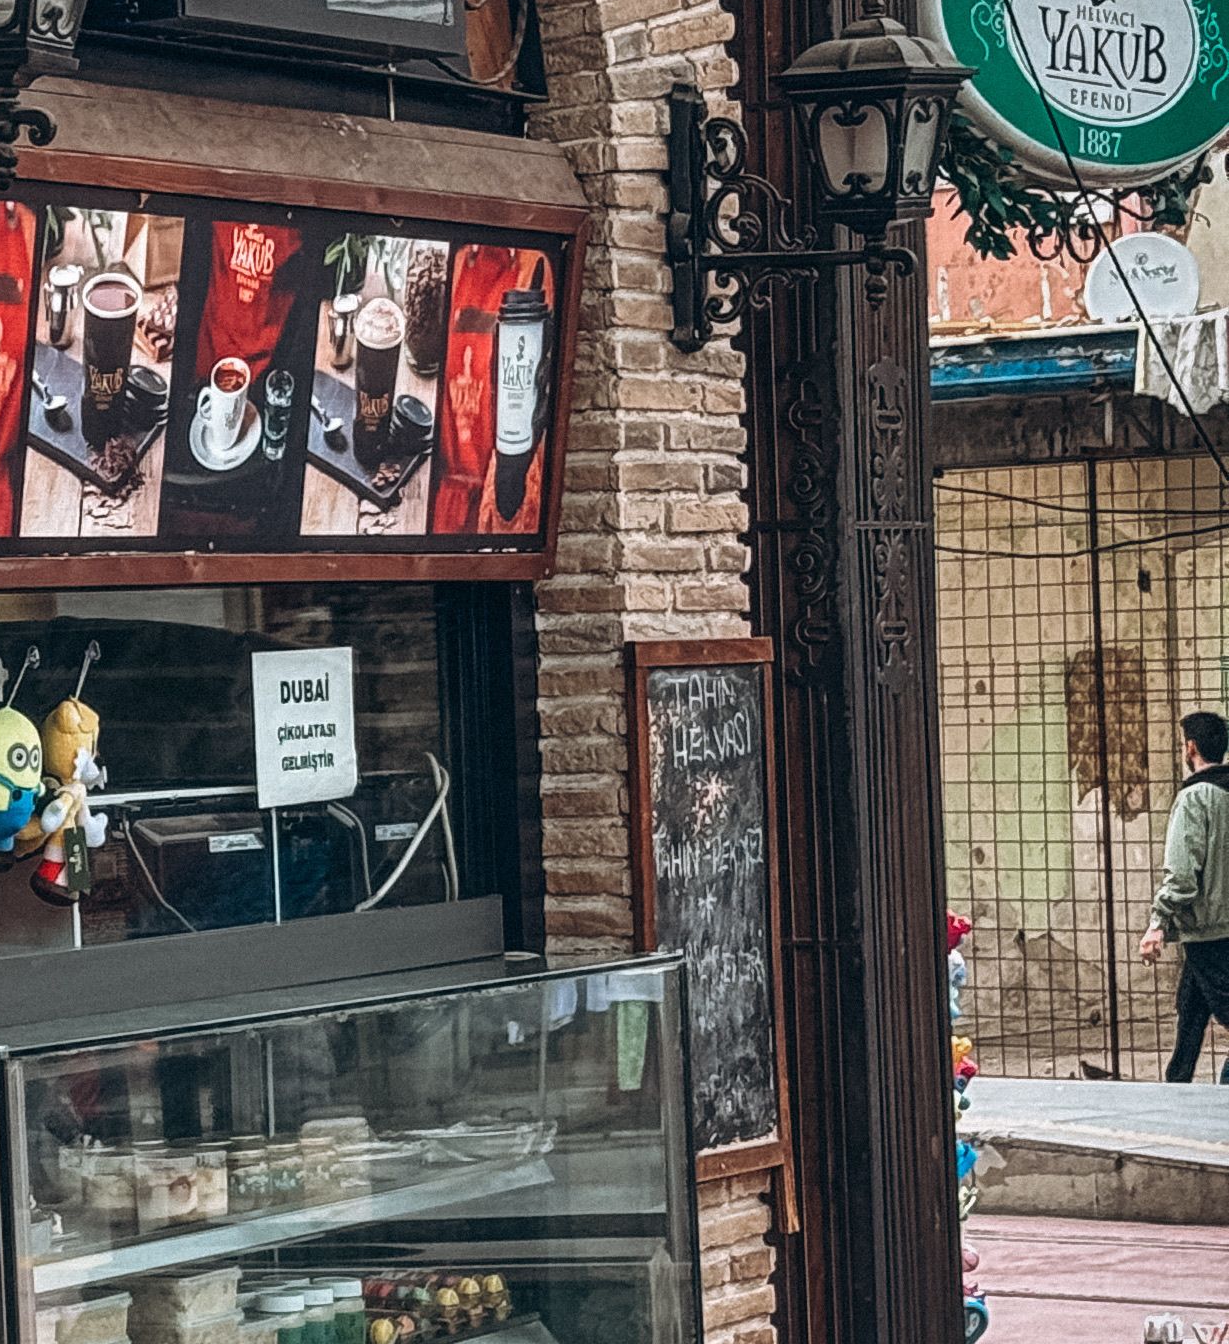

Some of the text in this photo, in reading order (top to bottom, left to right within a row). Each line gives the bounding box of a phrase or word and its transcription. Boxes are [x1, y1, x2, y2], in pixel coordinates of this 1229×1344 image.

[1076, 4, 1135, 28] HELVACI
[1038, 5, 1167, 90] YAKUB
[1078, 126, 1122, 158] 1887
[230, 226, 275, 278] YAKUB
[279, 671, 330, 705] DUBAİ
